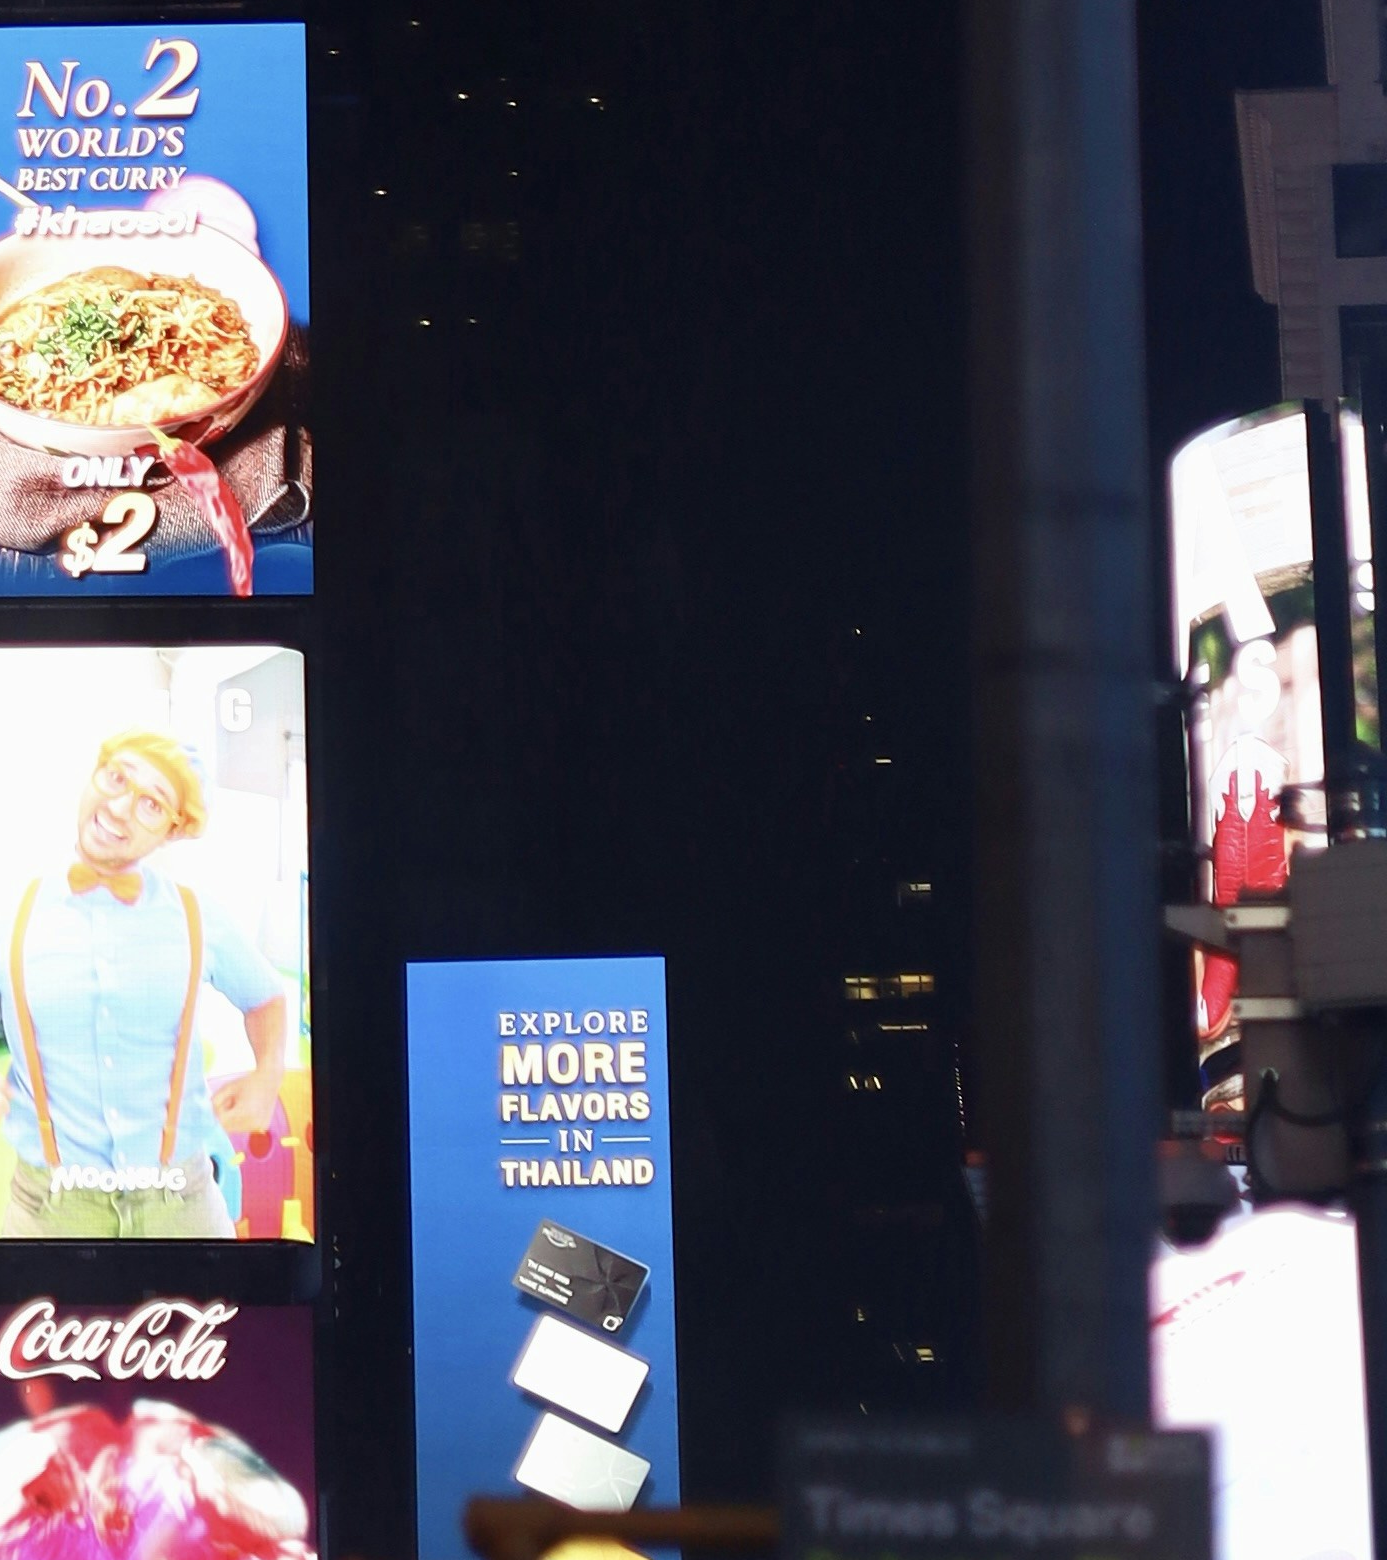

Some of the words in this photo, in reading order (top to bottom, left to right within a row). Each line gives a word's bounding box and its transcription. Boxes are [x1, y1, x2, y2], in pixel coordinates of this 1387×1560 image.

[17, 127, 186, 159] WORLD'S
[16, 167, 87, 192] BEST
[89, 166, 188, 192] CURRY
[62, 456, 156, 488] ONLY
[61, 491, 157, 578] $2
[498, 1010, 649, 1037] EXPLORE
[501, 1040, 648, 1086] MORE
[500, 1090, 651, 1122] FLAVORS
[558, 1129, 594, 1153] IN
[500, 1158, 655, 1187] THAILAND
